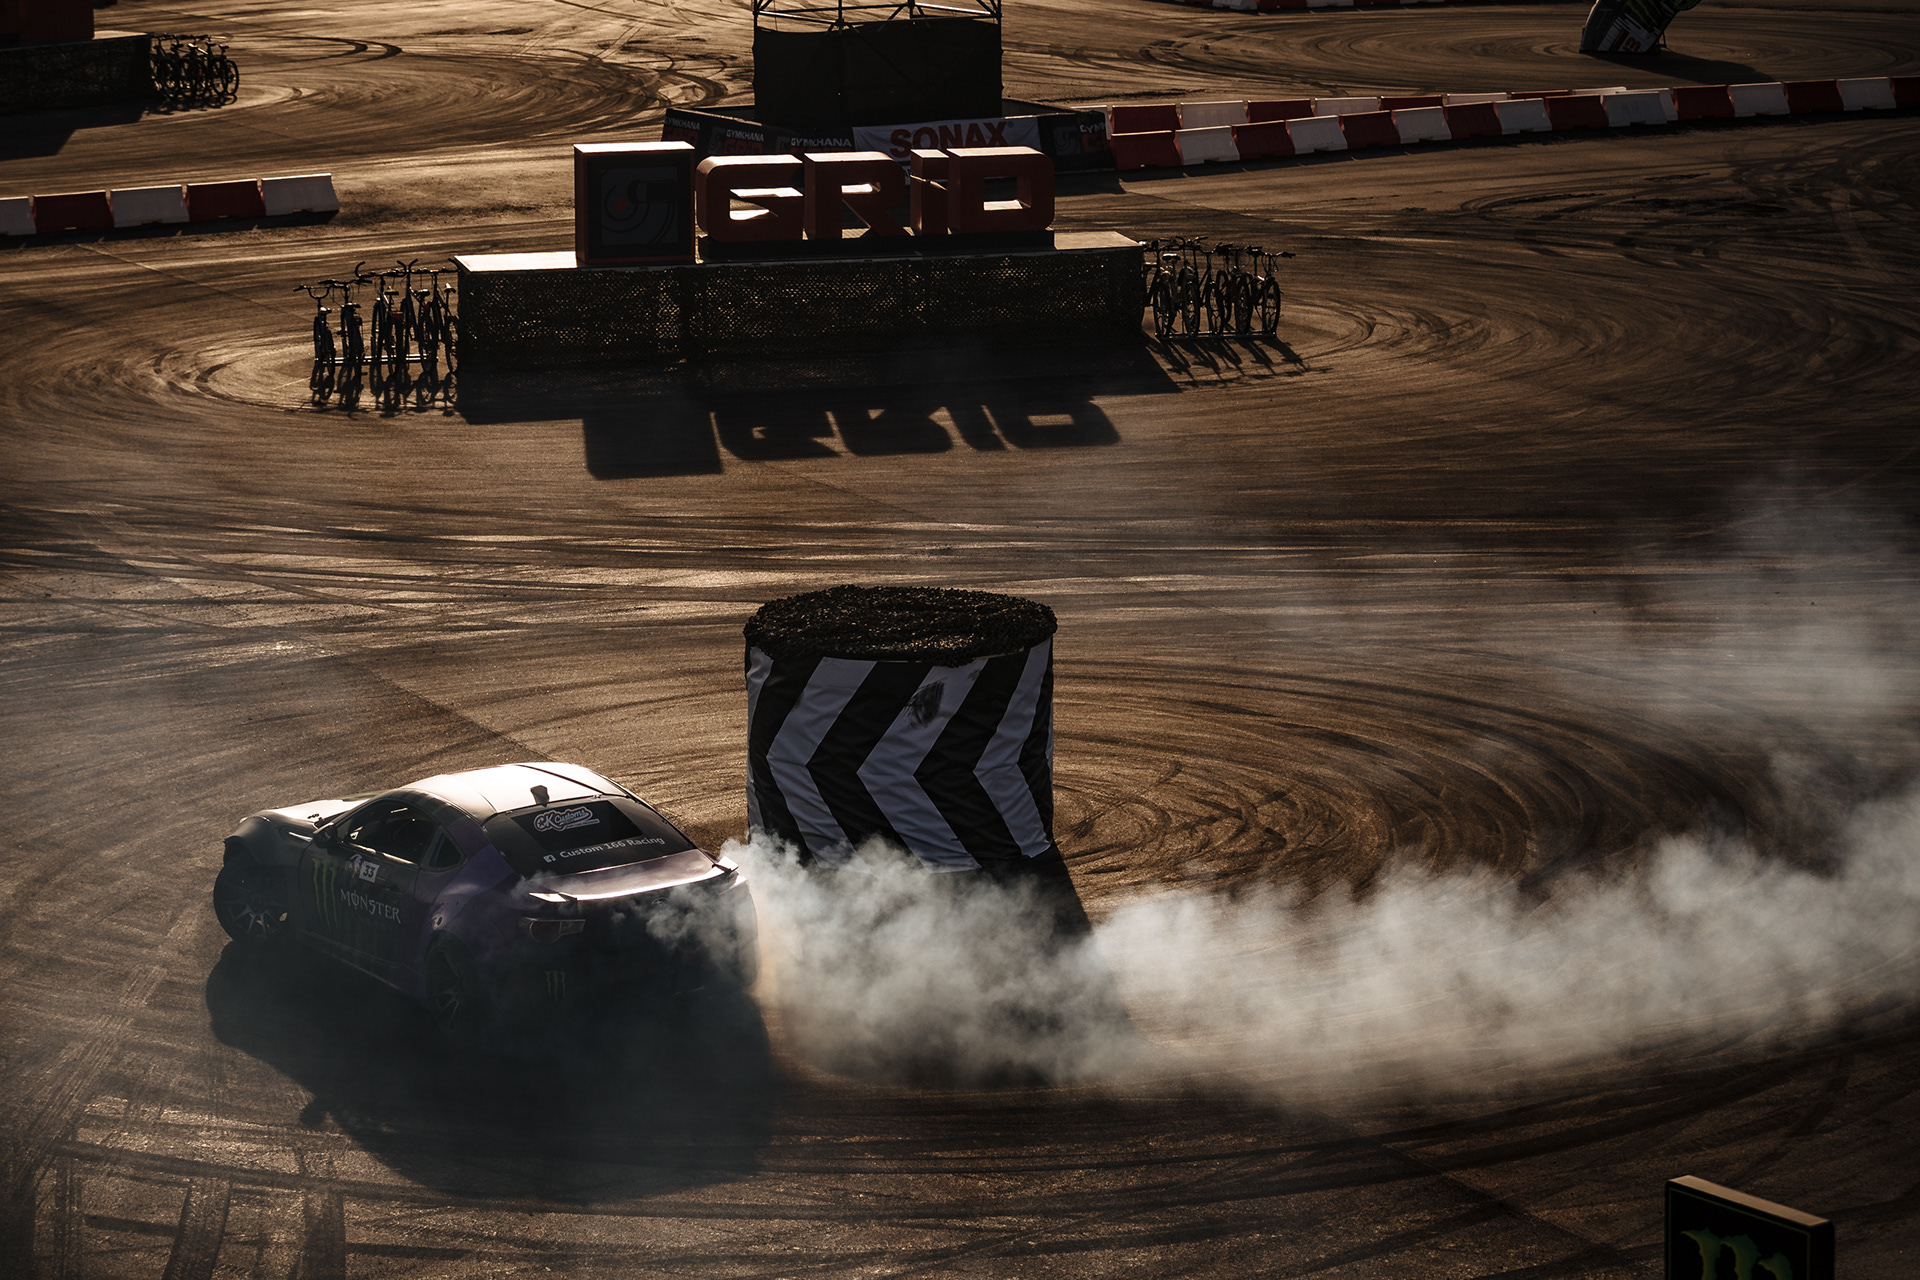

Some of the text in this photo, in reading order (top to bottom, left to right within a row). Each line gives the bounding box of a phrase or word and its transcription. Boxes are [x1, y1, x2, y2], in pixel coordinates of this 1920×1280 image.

[664, 116, 701, 131] GYMKHANA
[725, 128, 765, 143] GYMKHANA
[790, 137, 853, 148] GYMKHANA
[889, 121, 1010, 159] SONAX
[554, 808, 588, 825] Customs
[559, 844, 604, 859] Custom
[603, 840, 627, 851] 166
[626, 836, 666, 847] Racing
[362, 864, 377, 879] 33
